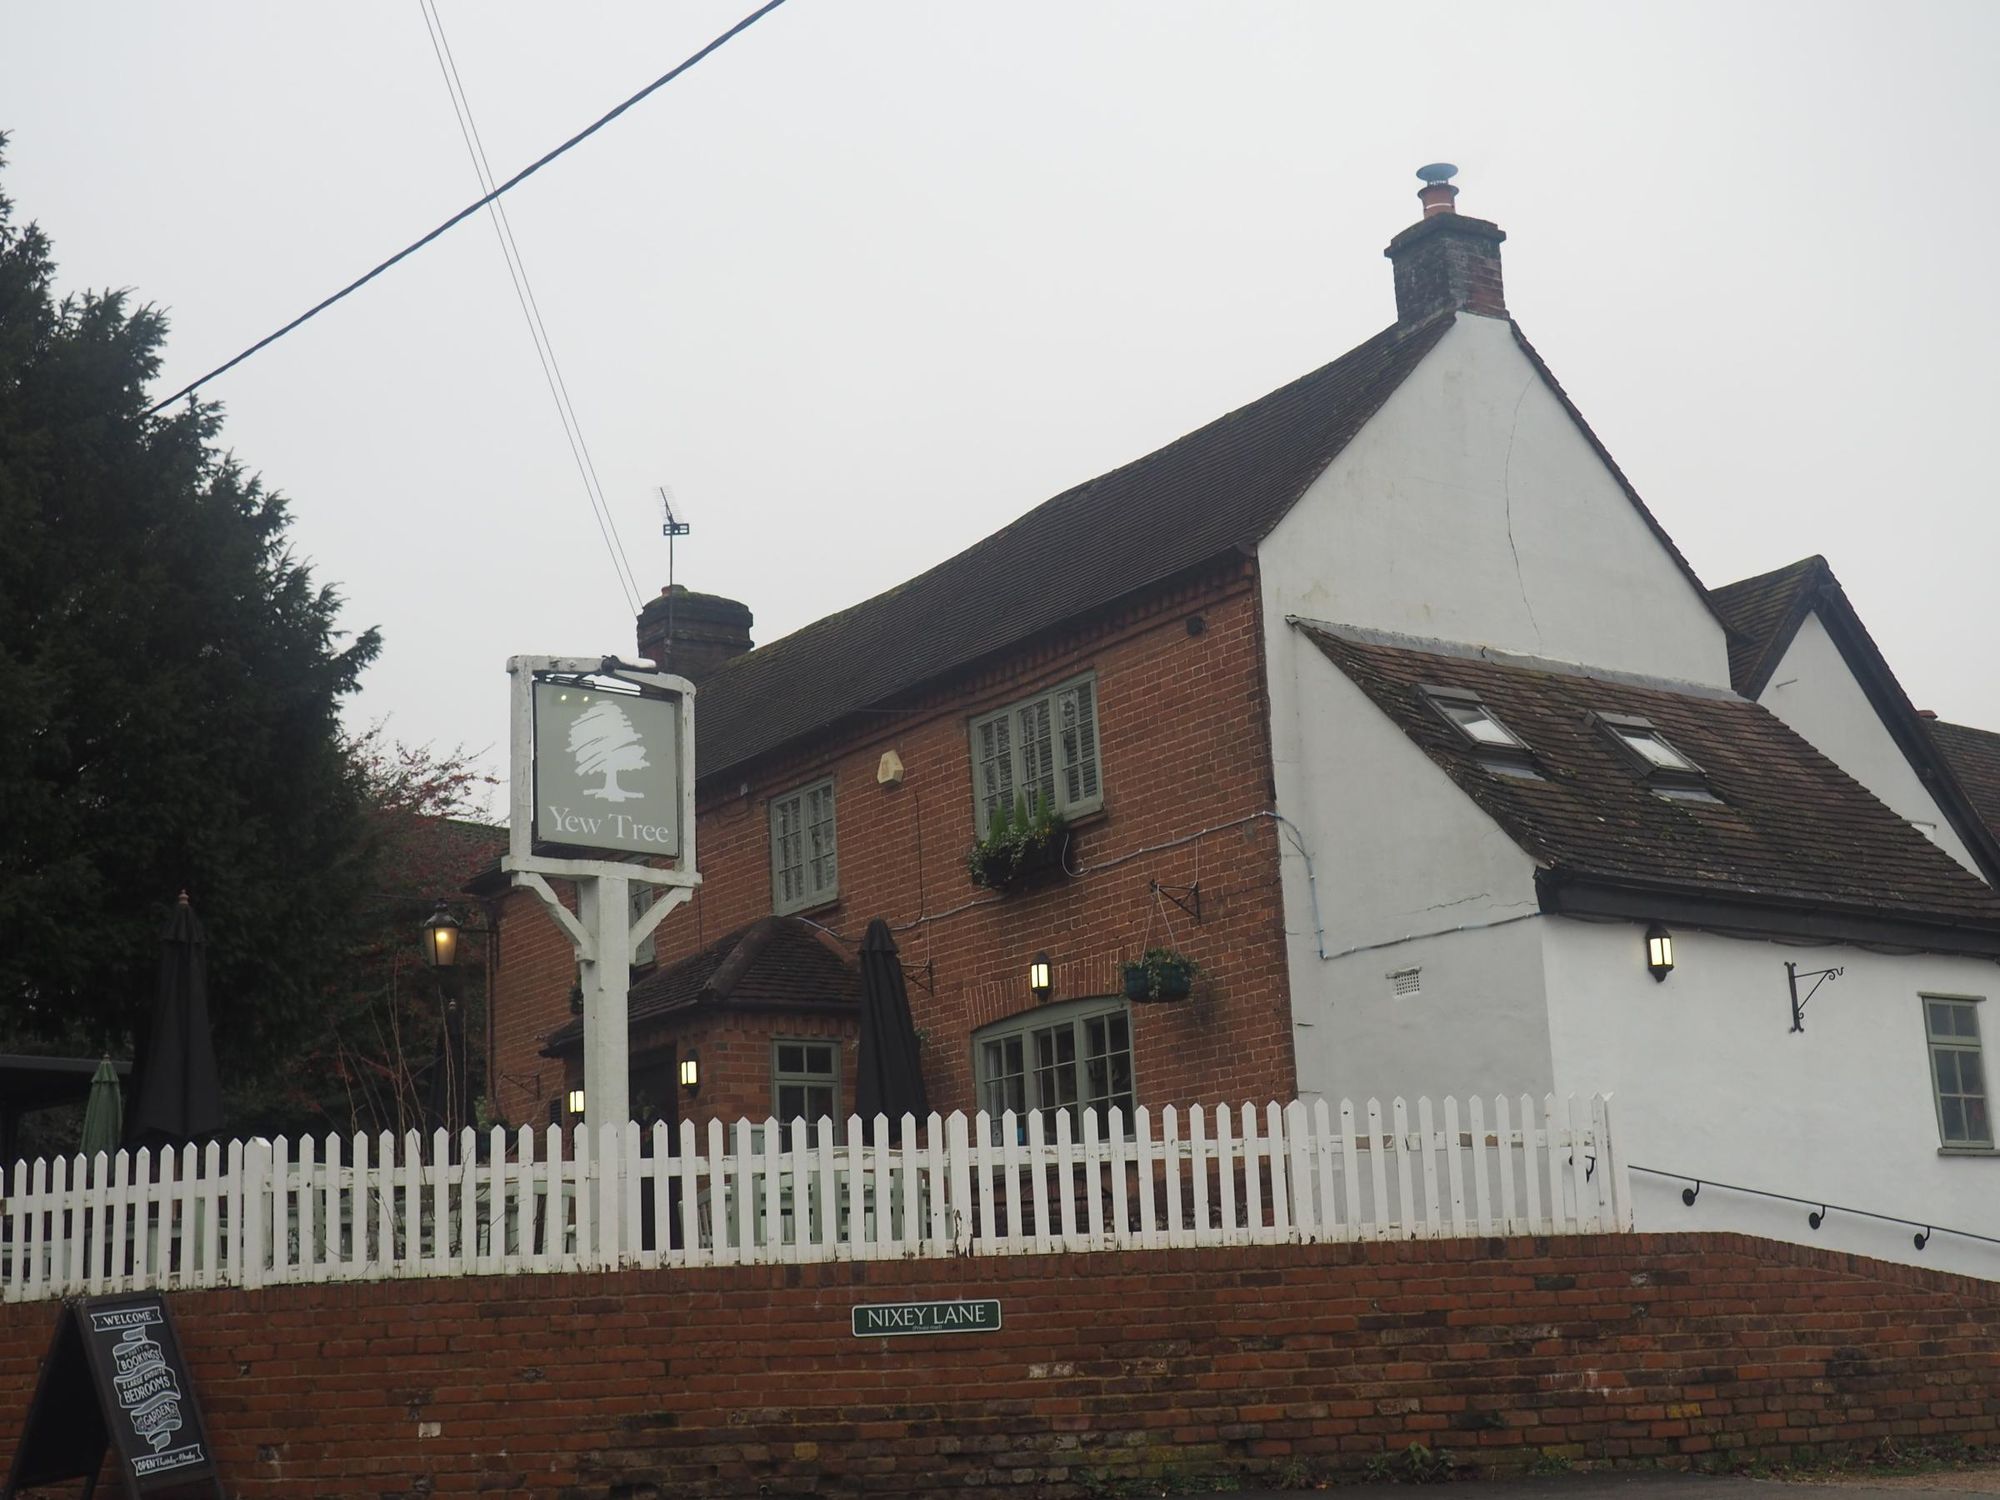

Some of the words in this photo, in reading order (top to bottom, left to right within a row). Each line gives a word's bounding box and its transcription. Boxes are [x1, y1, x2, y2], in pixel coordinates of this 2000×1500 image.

[549, 806, 602, 835] Yew
[608, 813, 669, 843] Tree
[102, 1311, 152, 1326] WELCOME
[867, 1306, 927, 1328] NIXEY
[933, 1304, 986, 1325] LANE
[120, 1349, 161, 1370] BOOKINGS
[123, 1376, 171, 1403] BEDROOMS
[143, 1402, 171, 1426] GARDEN
